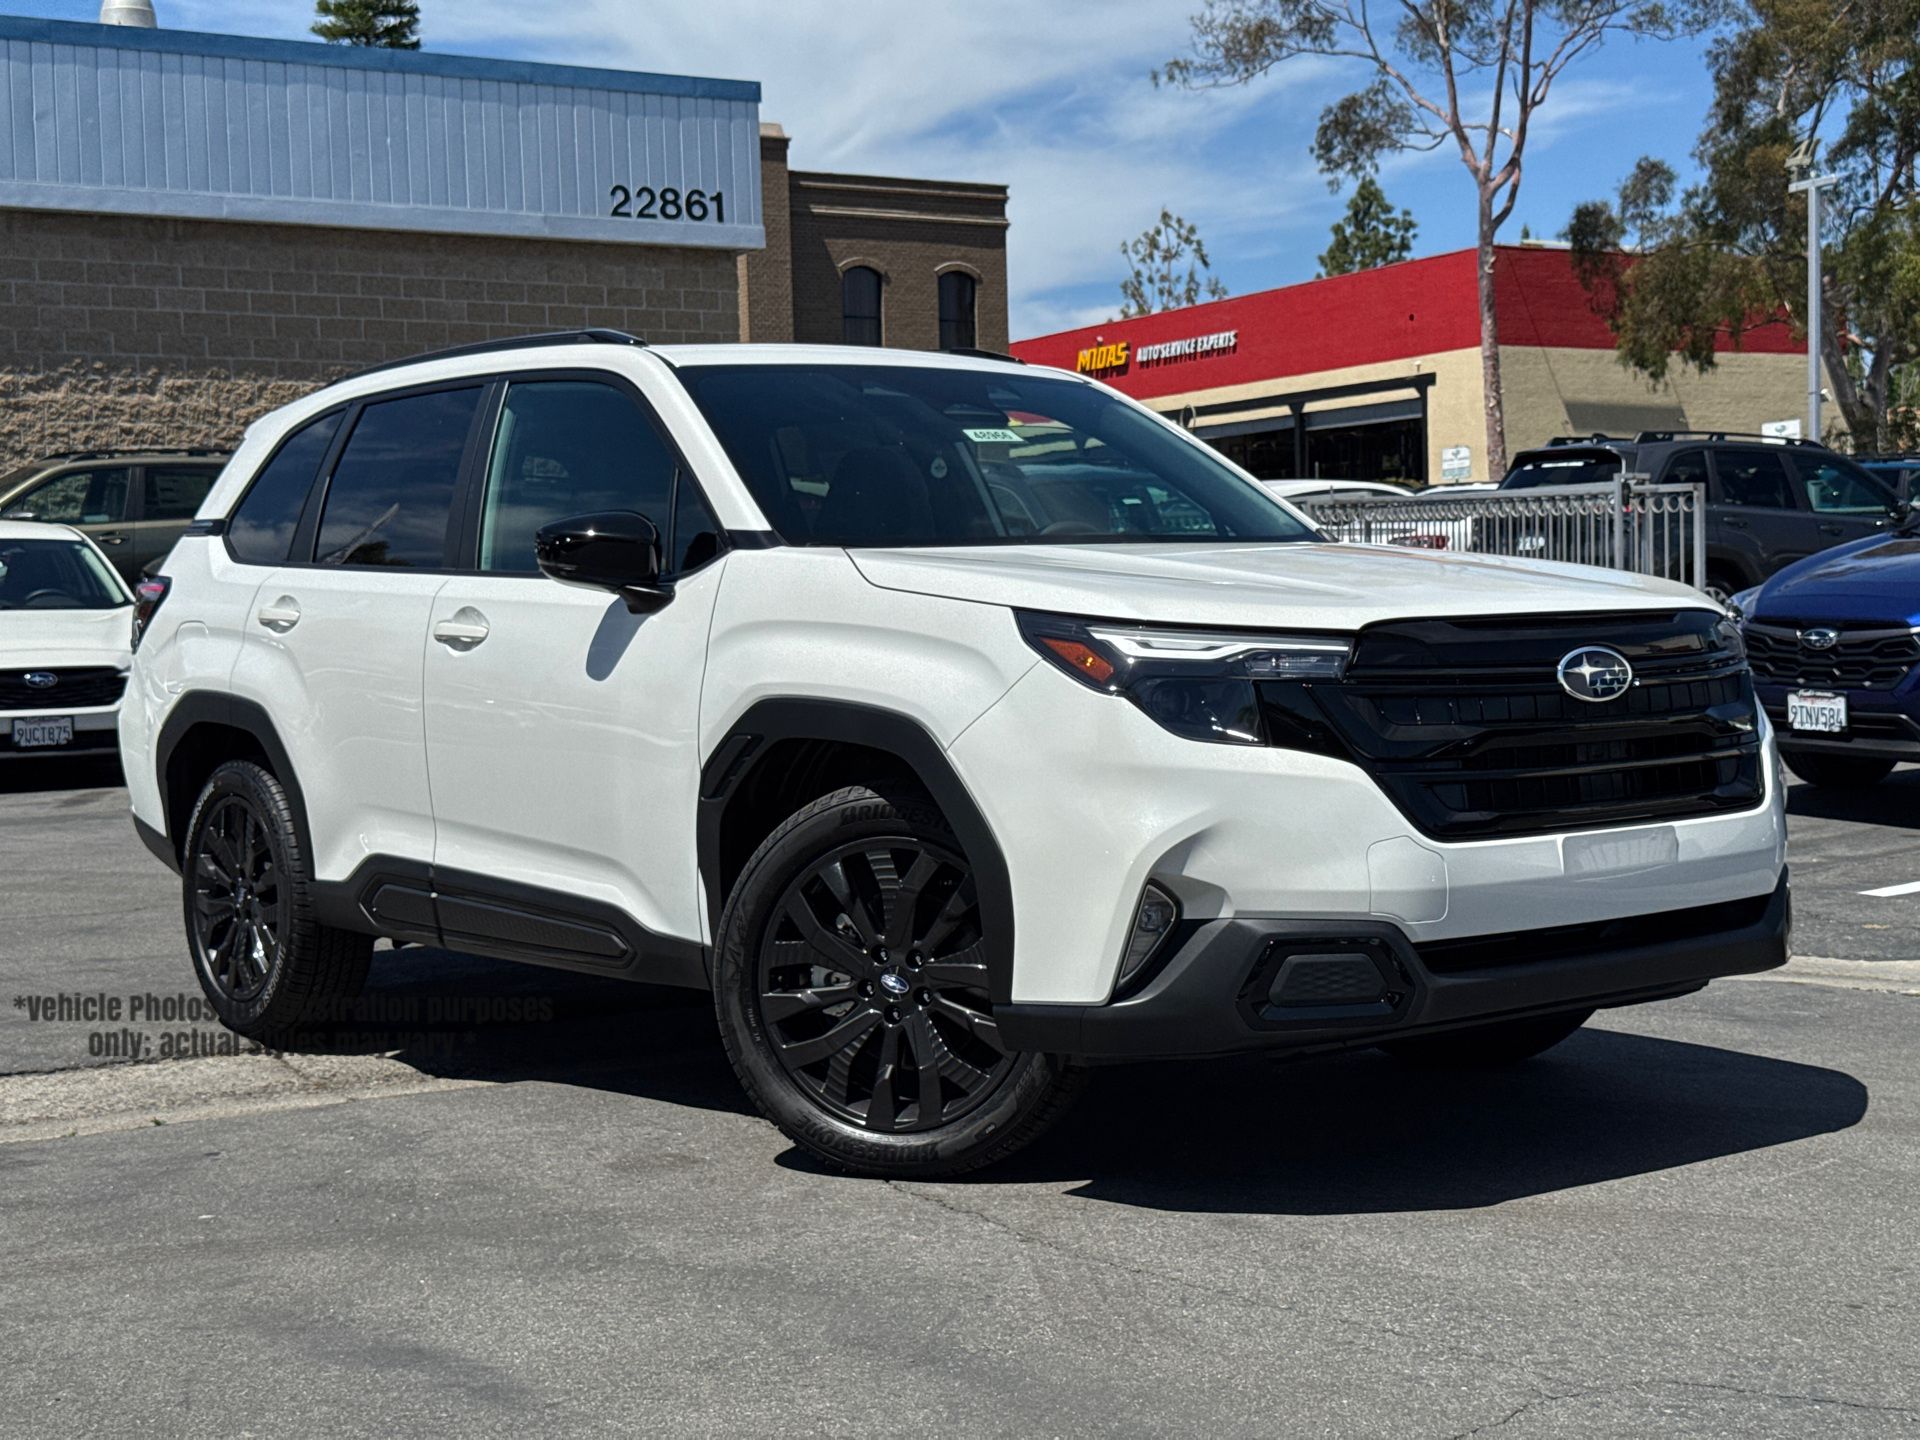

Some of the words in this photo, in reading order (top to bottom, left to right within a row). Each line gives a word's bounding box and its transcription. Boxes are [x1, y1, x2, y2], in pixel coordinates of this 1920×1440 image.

[610, 184, 724, 223] 22861
[1076, 342, 1129, 372] MIDAS
[1136, 345, 1160, 363] AUTO
[1160, 337, 1196, 358] SERVICE
[1196, 330, 1238, 352] EXPERTS
[1790, 705, 1843, 728] 9TNV584
[793, 1115, 938, 1163] BRIDGESTONE
